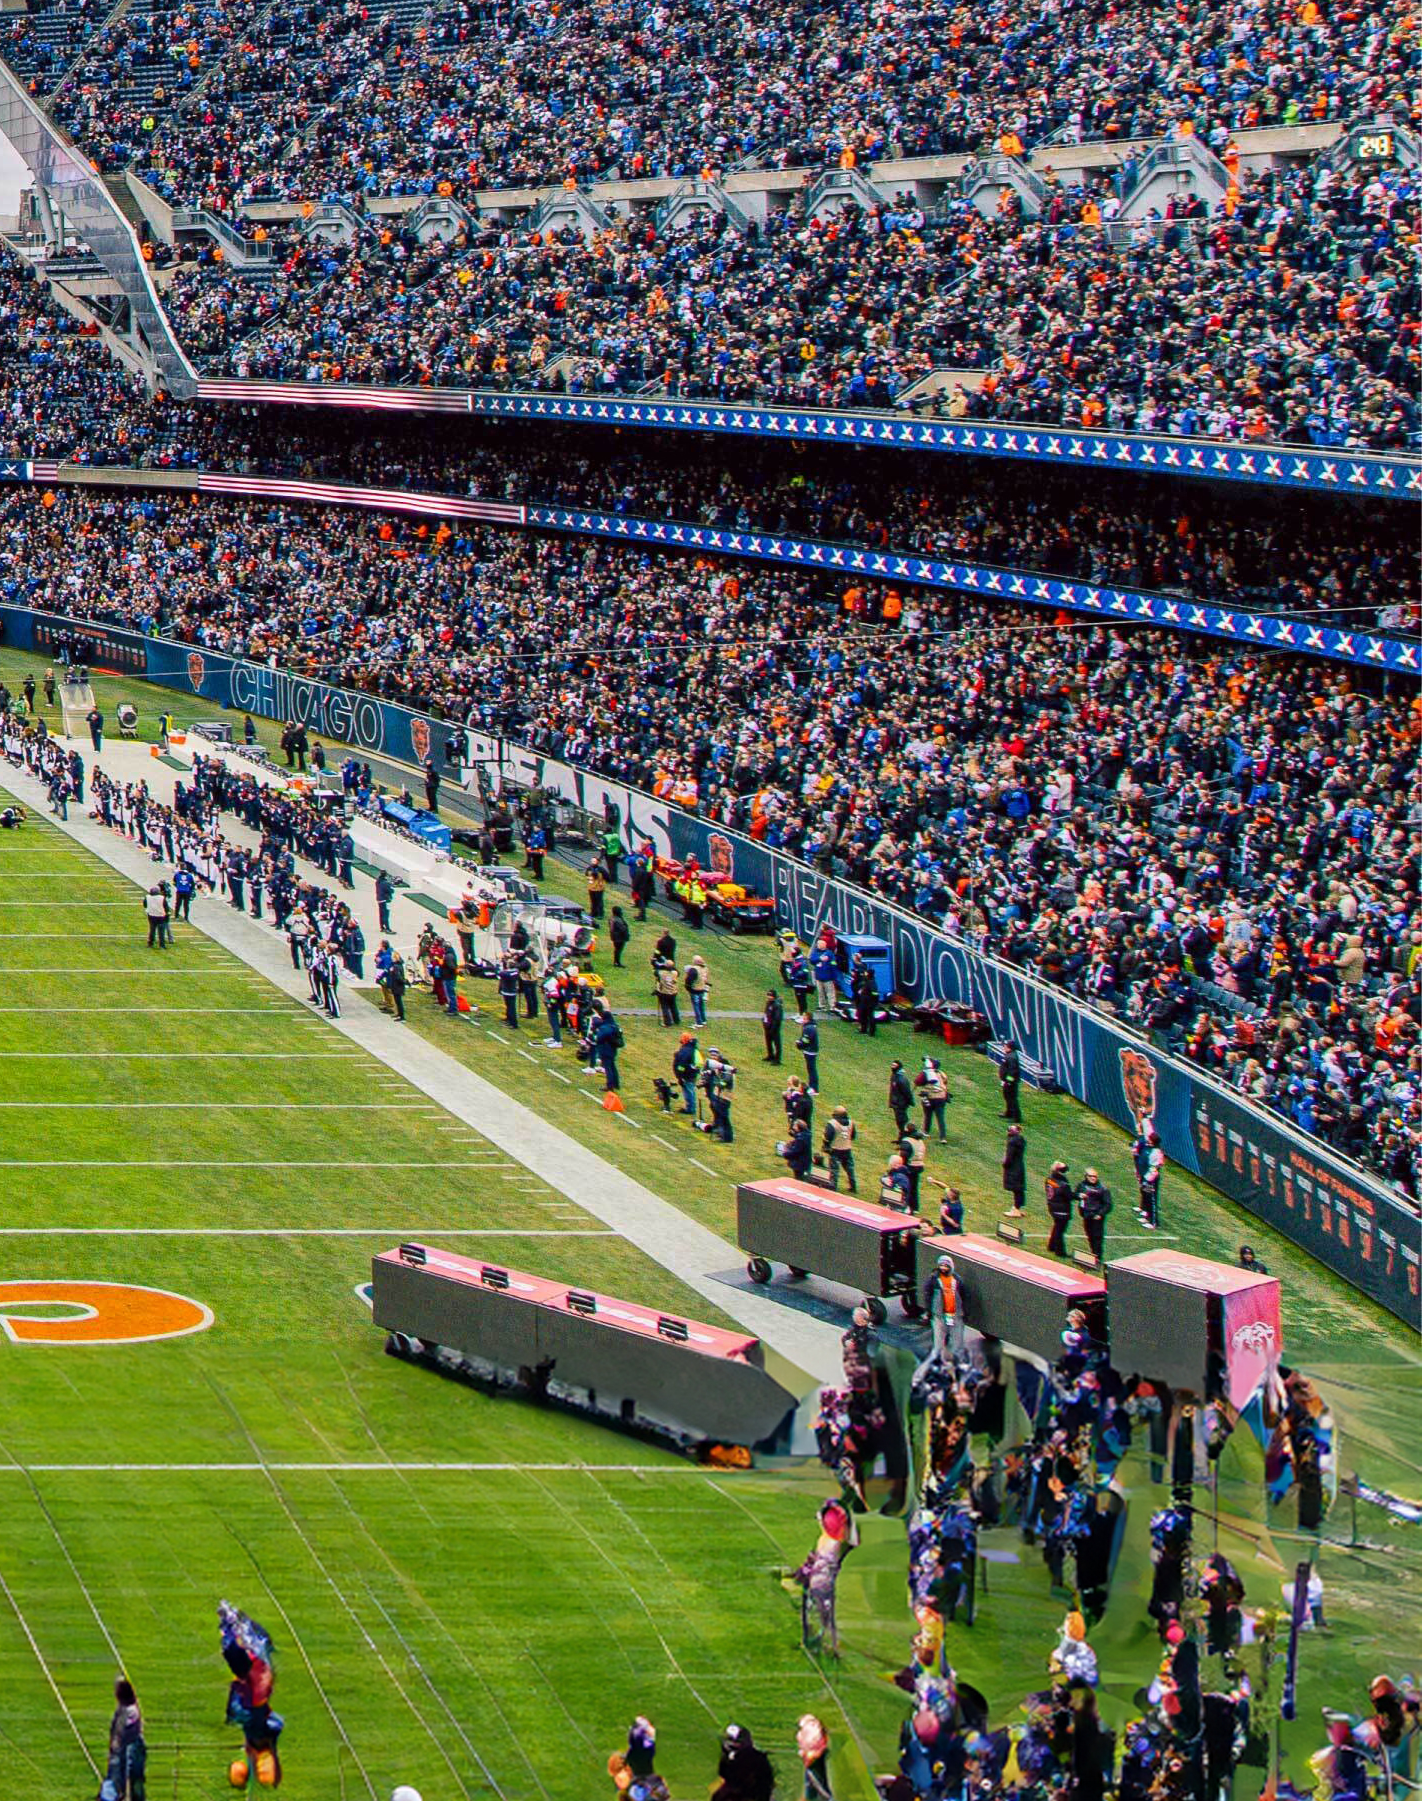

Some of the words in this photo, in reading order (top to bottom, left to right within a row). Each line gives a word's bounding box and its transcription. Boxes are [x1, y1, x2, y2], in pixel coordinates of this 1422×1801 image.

[230, 661, 385, 753] CHICAGO
[772, 853, 877, 955] BEAR
[892, 911, 1086, 1102] DOWN
